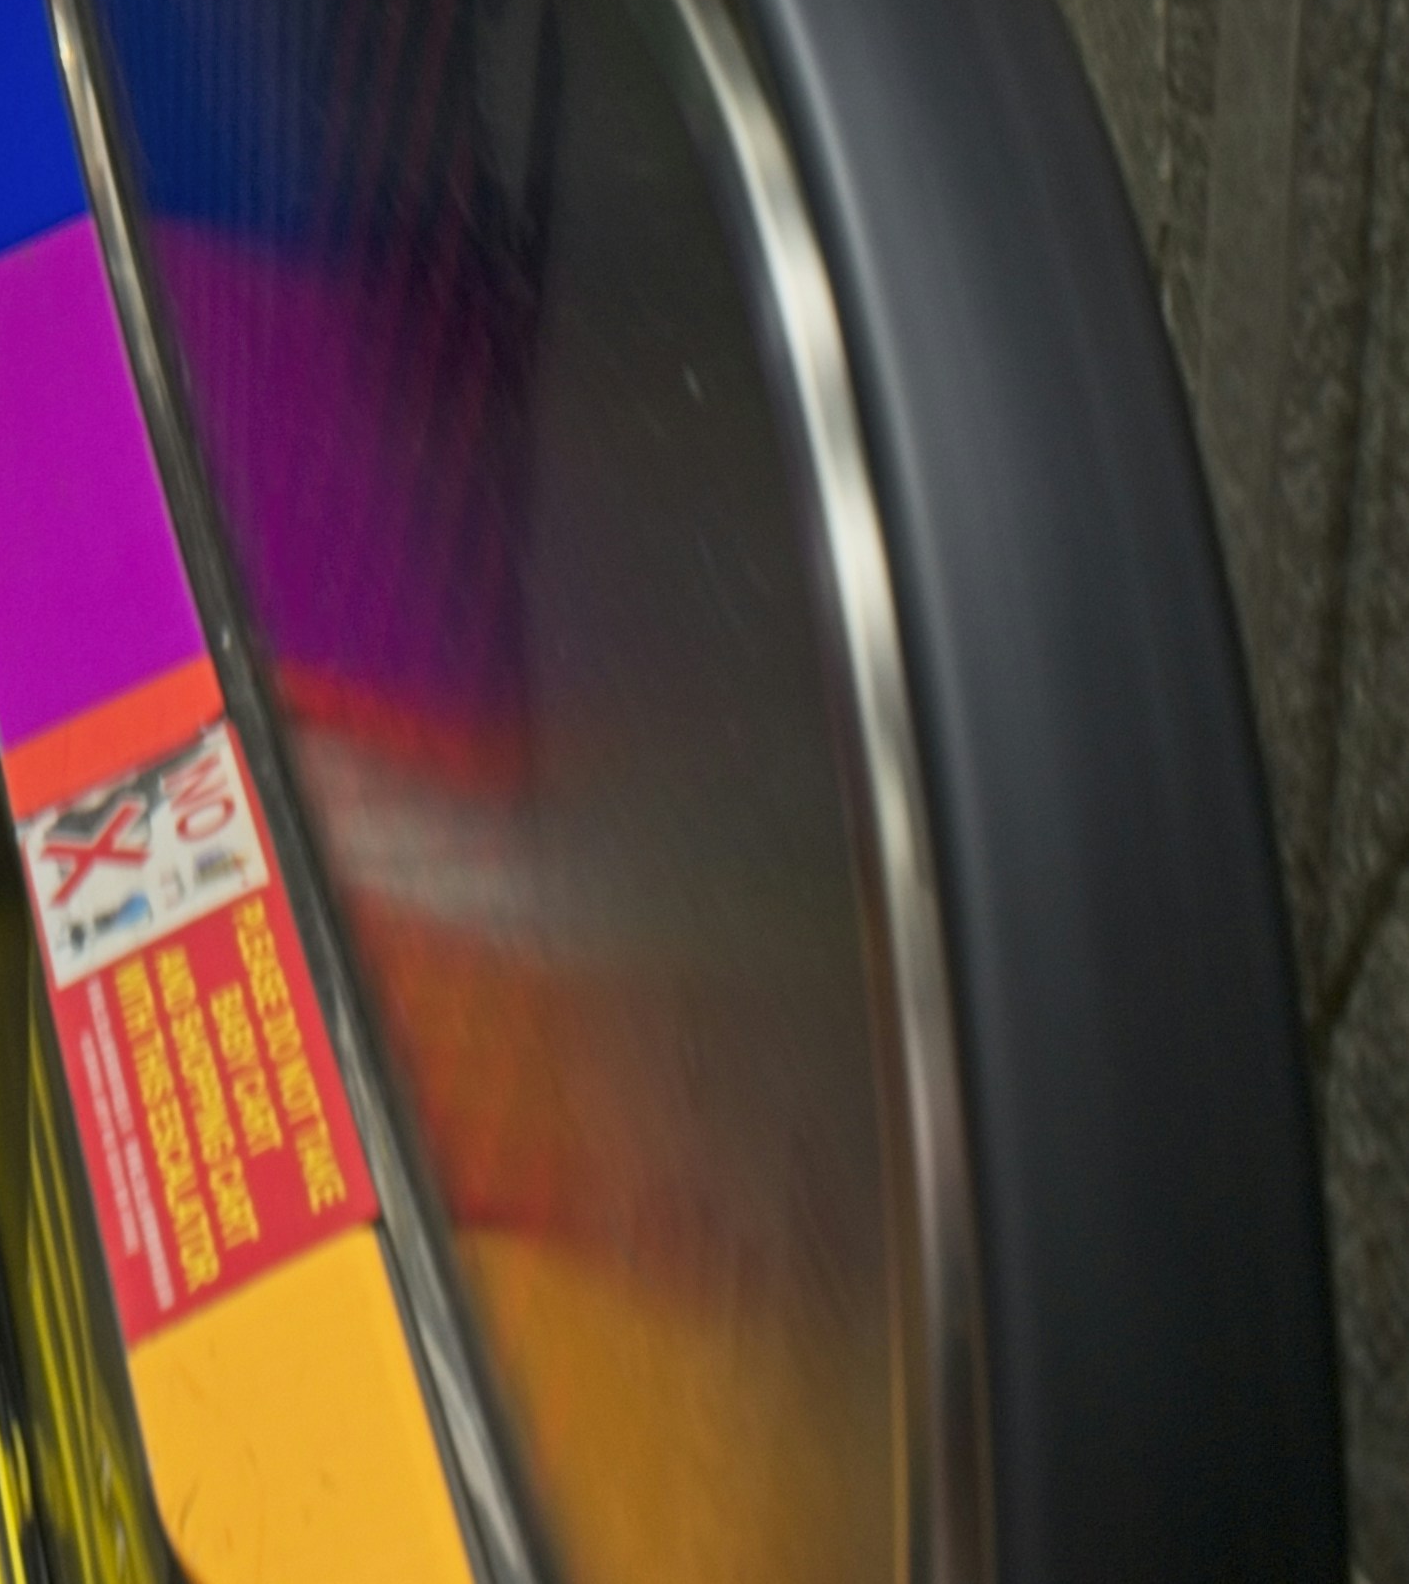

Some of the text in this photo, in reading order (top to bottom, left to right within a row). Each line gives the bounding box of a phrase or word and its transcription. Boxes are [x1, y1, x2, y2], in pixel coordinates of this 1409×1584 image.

[168, 755, 235, 839] NO
[209, 982, 282, 1154] BABY CART
[261, 1005, 302, 1063] DO
[114, 958, 158, 1039] WITH
[146, 1093, 219, 1291] ESCALATOR
[155, 947, 259, 1247] AND SHOPPING CART
[276, 1053, 322, 1121] NOT
[295, 1116, 346, 1212] TAKE
